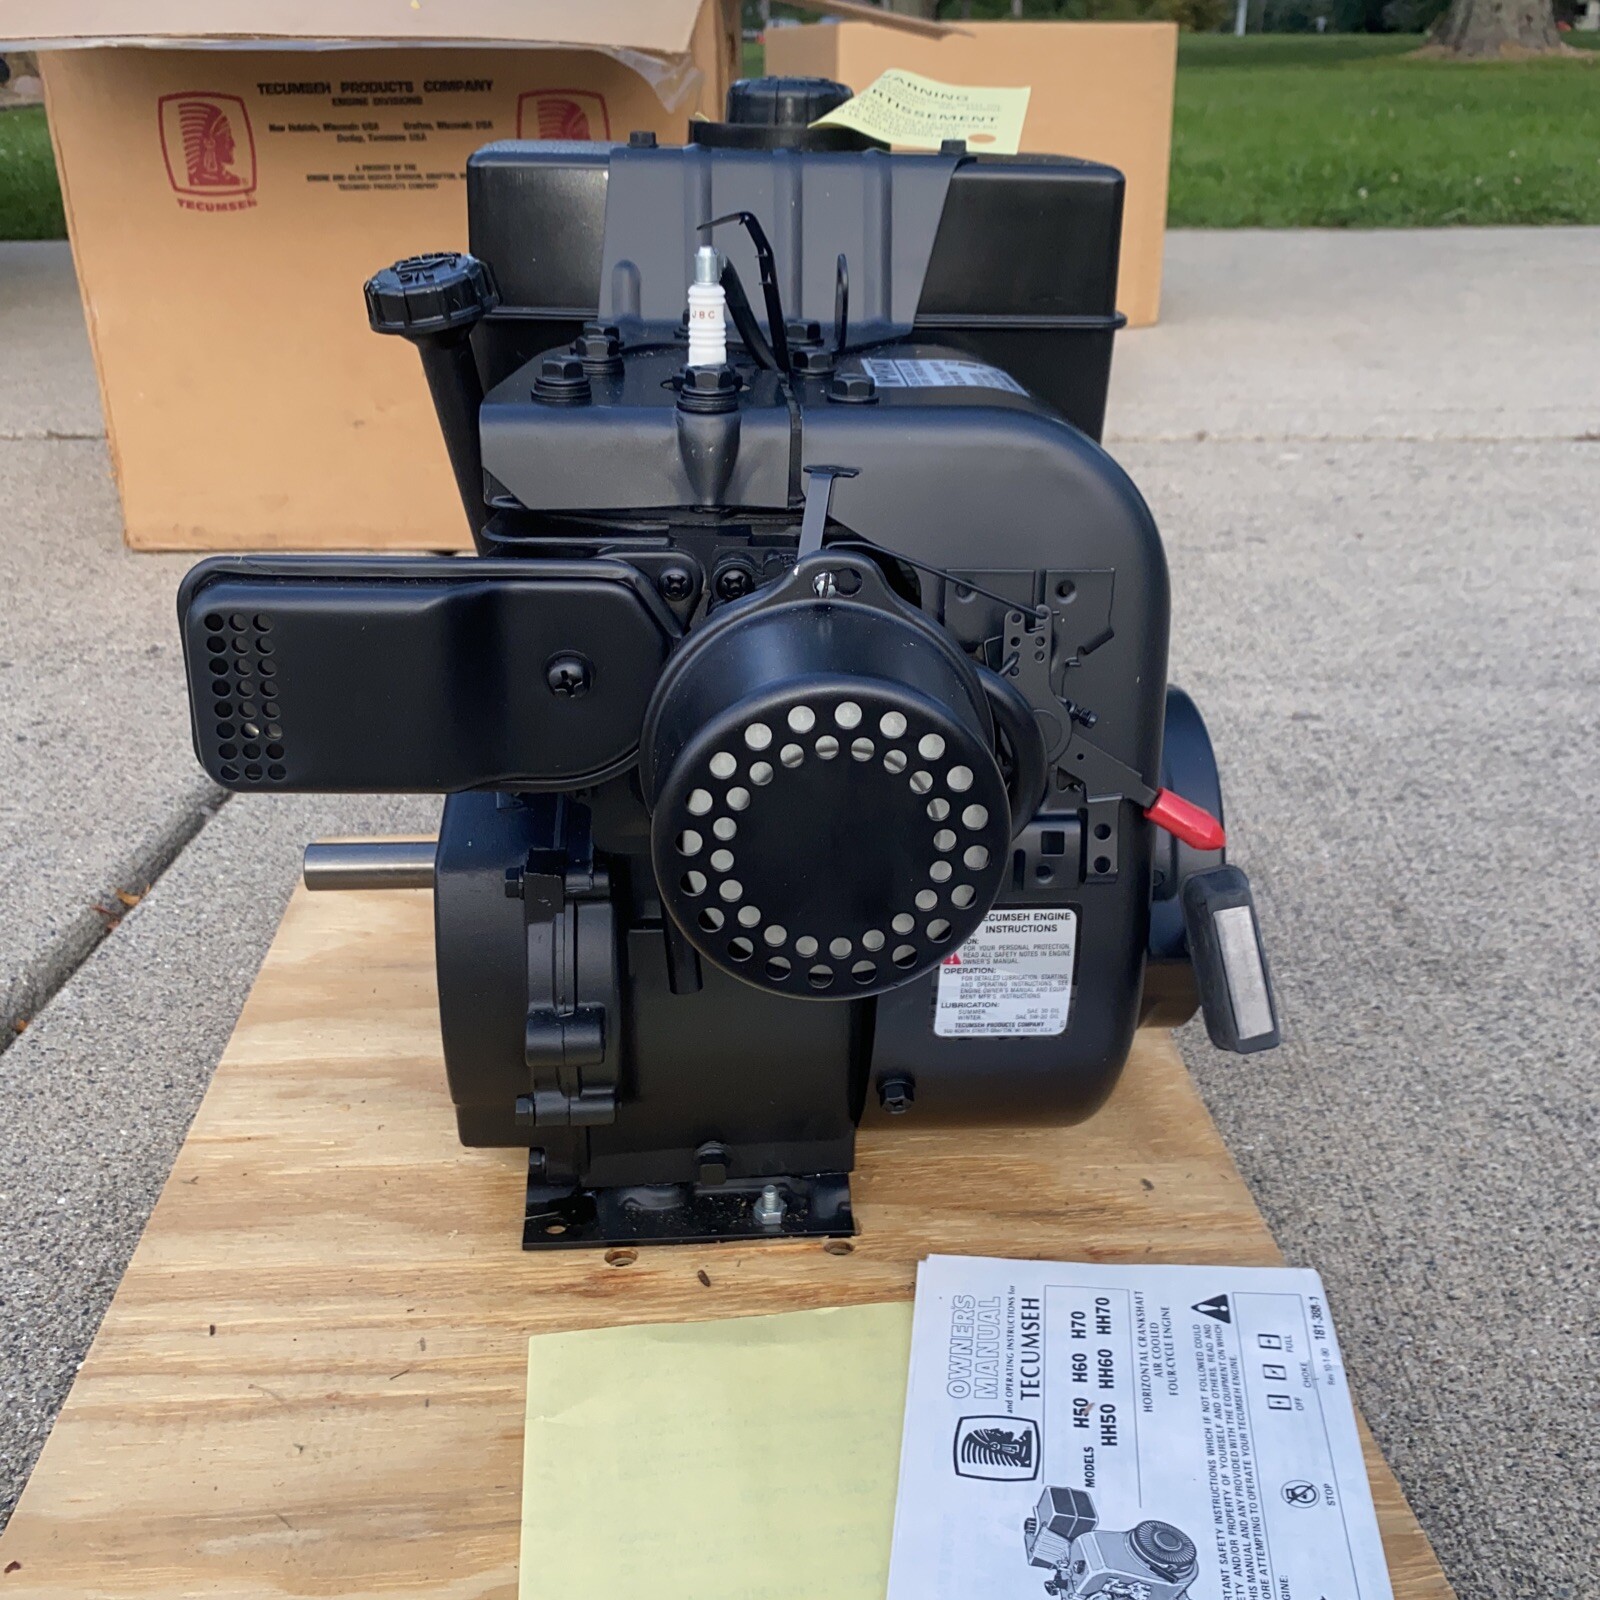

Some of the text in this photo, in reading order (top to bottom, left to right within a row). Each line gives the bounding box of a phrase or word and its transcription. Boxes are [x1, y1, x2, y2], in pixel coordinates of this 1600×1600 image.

[257, 79, 493, 95] TECUMSEH PRODUCTS COMPANY
[177, 199, 257, 211] TECUMSEH
[985, 924, 1058, 933] INSTRUCTIONS
[1034, 912, 1071, 921] ENGINE
[1160, 1306, 1173, 1339] ENGINE
[1203, 1324, 1213, 1339] AND
[1214, 1324, 1224, 1347] WHICH
[946, 1294, 976, 1399] OWNER'S
[974, 1296, 1001, 1400] MANUAL
[1005, 1285, 1016, 1414] and OPERATING INSTRUCTIONS for
[1020, 1297, 1041, 1401] TECUMSEH
[1150, 1322, 1164, 1378] AIR COOLED
[1192, 1324, 1203, 1349] COULD
[1284, 1335, 1294, 1353] FULL
[1134, 1291, 1154, 1413] HORIZONTAL CRANKSHAFT
[1205, 1342, 1215, 1363] READ
[1218, 1349, 1226, 1361] ON
[1071, 1311, 1090, 1429] H50 H60 H70
[1095, 1297, 1118, 1446] HH50 HH60 HH70
[1196, 1351, 1208, 1392] FOLLOWED
[1300, 1362, 1312, 1388] CHOKE
[1219, 1362, 1232, 1407] EQUIPMENT
[1201, 1395, 1210, 1413] NOT
[1213, 1402, 1222, 1419] AND
[1225, 1409, 1234, 1424] THE
[1233, 1387, 1247, 1430] TECUMSEH
[1294, 1397, 1304, 1411] OFF
[1203, 1416, 1212, 1424] IF
[1204, 1427, 1215, 1456] WHICH
[1215, 1423, 1228, 1469] YOURSELF
[1227, 1427, 1237, 1449] WITH
[1239, 1433, 1250, 1457] YOUR
[1083, 1446, 1096, 1488] MODELS
[1221, 1473, 1231, 1486] OF
[1230, 1451, 1244, 1497] PROVIDED
[1243, 1460, 1257, 1500] OPERATE
[1207, 1459, 1223, 1524] INSTRUCTIONS
[1323, 1483, 1336, 1506] STOP
[1223, 1489, 1237, 1536] PROPERTY
[1235, 1499, 1247, 1518] ANY
[1249, 1502, 1258, 1514] TO
[1240, 1520, 1250, 1539] AND
[1215, 1528, 1229, 1565] SAFETY
[1229, 1539, 1243, 1577] AND/OR
[1251, 1516, 1268, 1577] ATTEMPTING
[1242, 1541, 1256, 1583] MANUAL
